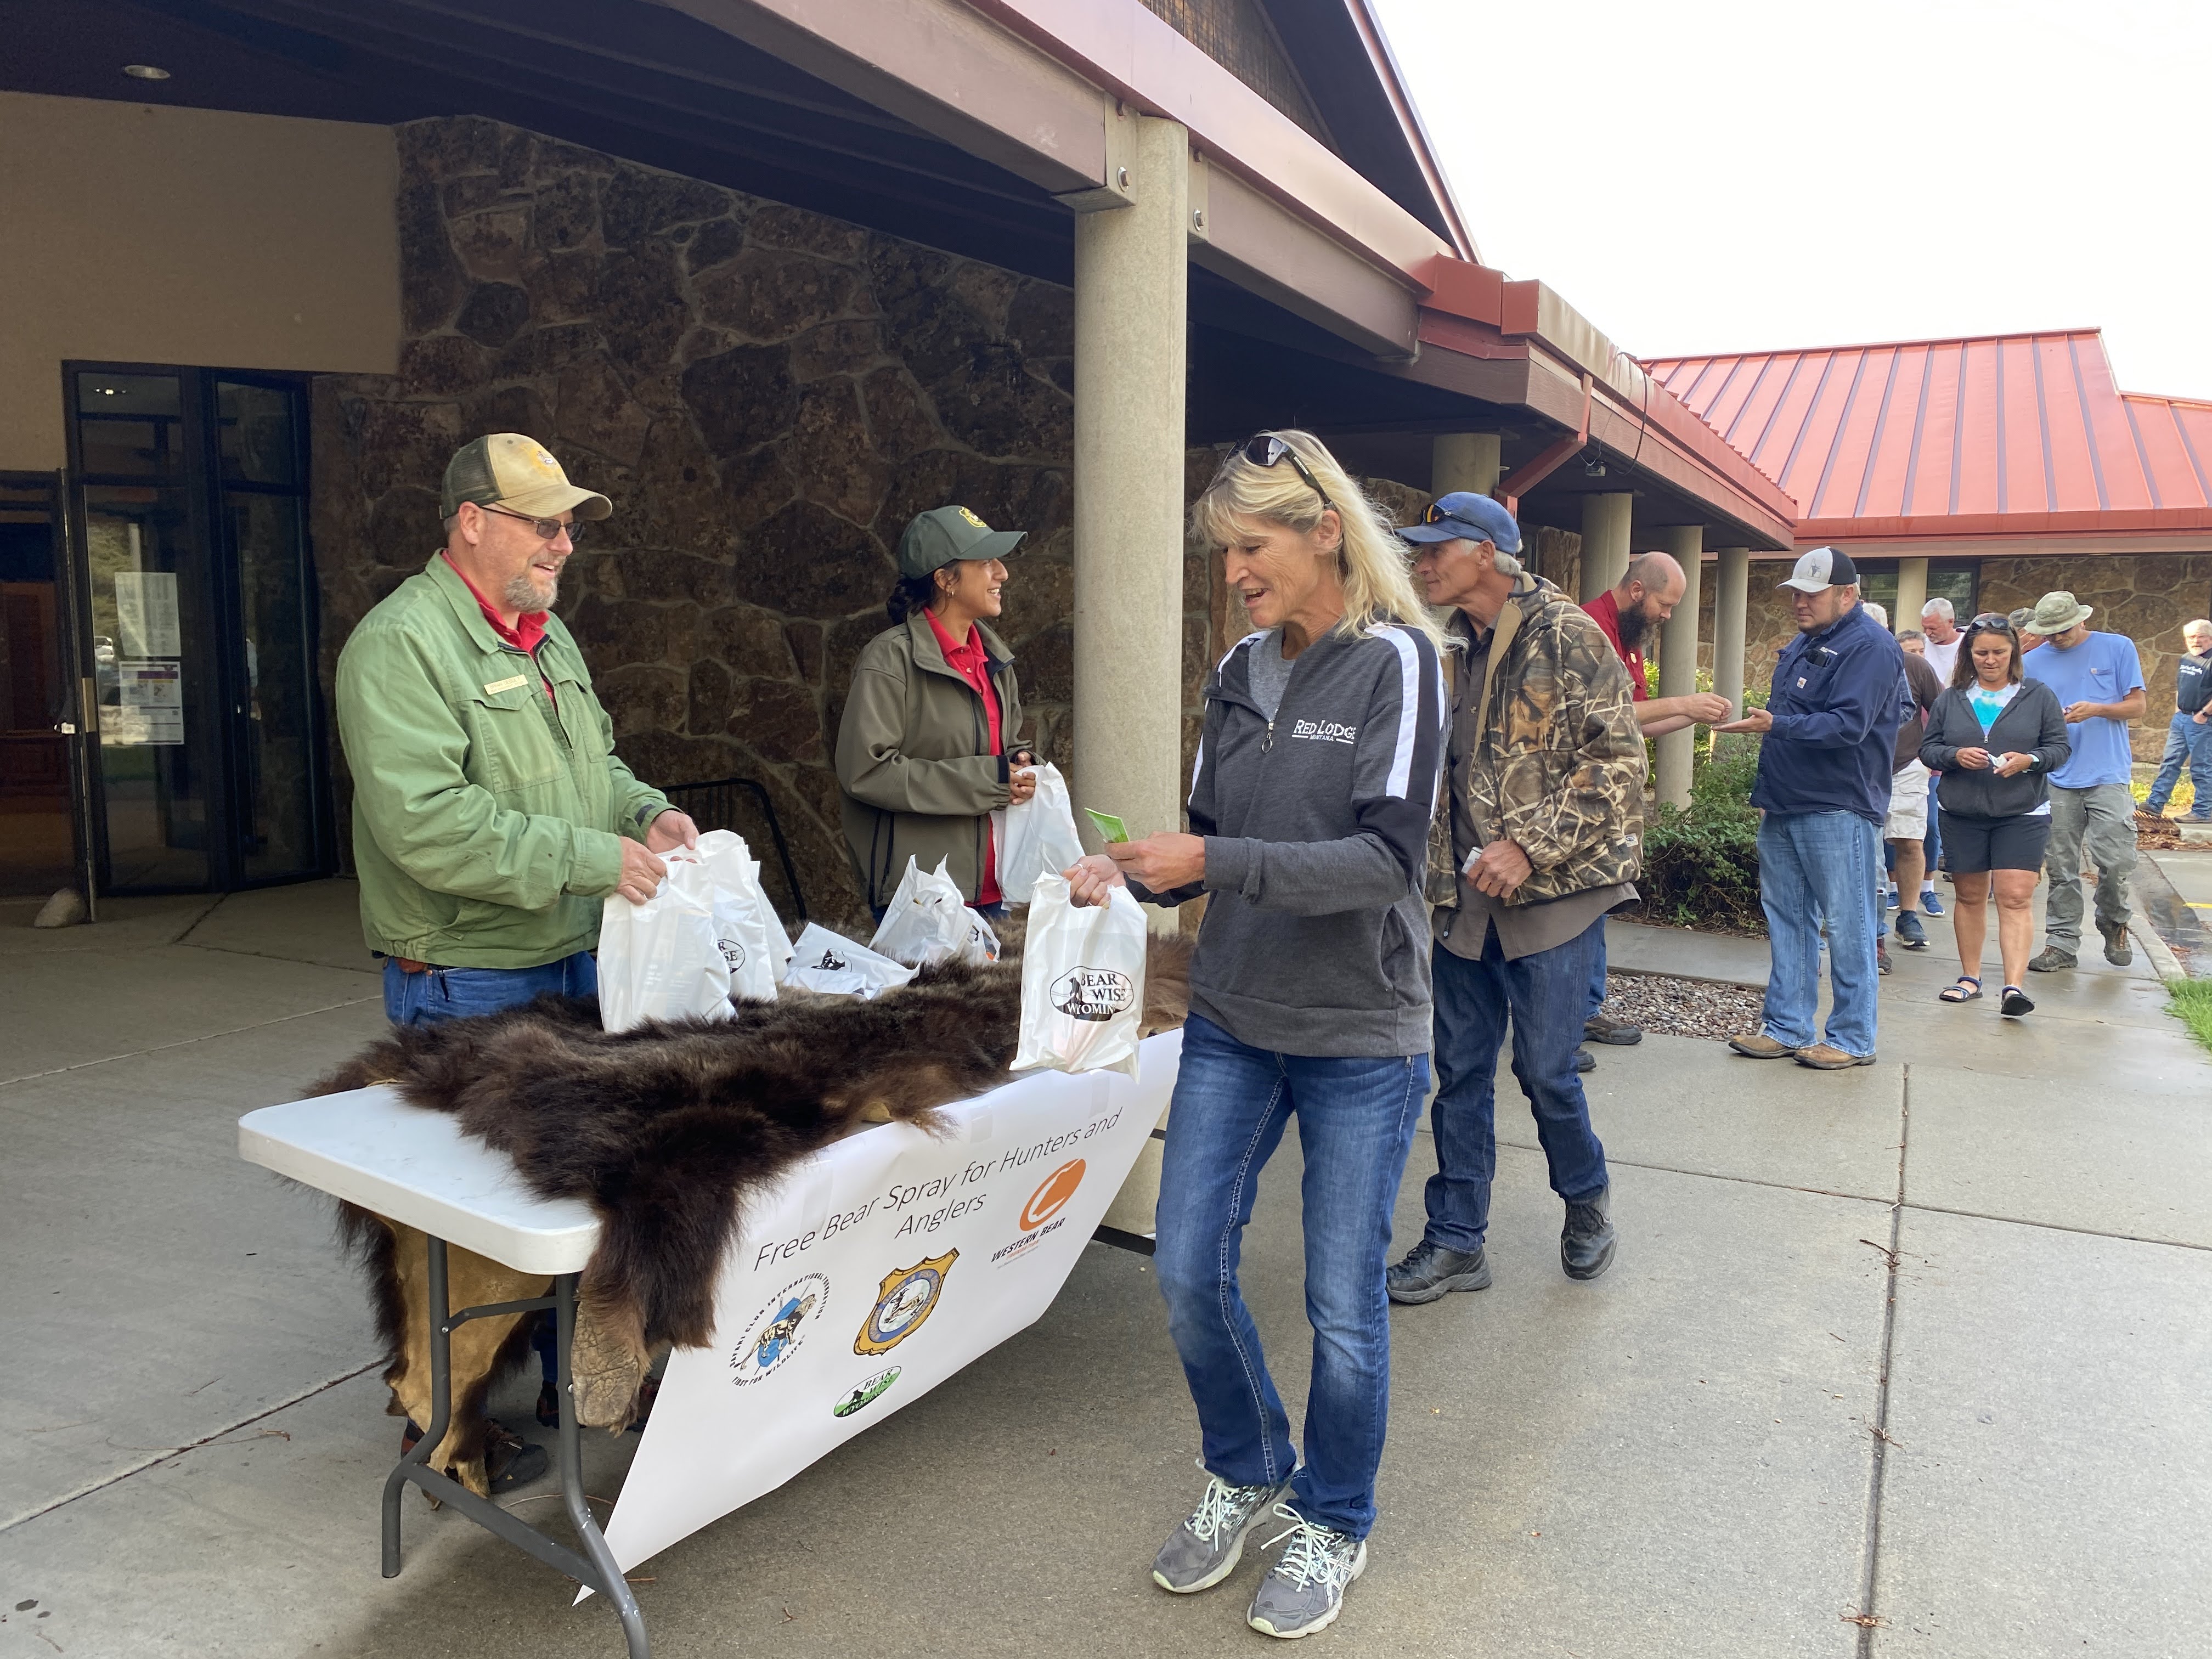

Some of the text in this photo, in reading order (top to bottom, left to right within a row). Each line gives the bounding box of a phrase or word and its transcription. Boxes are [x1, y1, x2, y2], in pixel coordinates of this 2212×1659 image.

[1293, 719, 1357, 740] RED LODGE
[1081, 972, 1121, 987] BEAR
[753, 1106, 1123, 1272] Free Bear Spray for Hunters and
[894, 1194, 986, 1239] Anglers
[991, 1230, 1040, 1263] WESTERN
[1039, 1217, 1066, 1237] BEAR
[729, 1336, 746, 1368] SAFARI
[744, 1309, 765, 1333] CLUB
[768, 1272, 825, 1307] INTERNATIONAL
[732, 1376, 748, 1387] FIRST
[748, 1374, 763, 1386] FOR
[862, 1369, 893, 1391] BEAR
[869, 1375, 894, 1394] WISE
